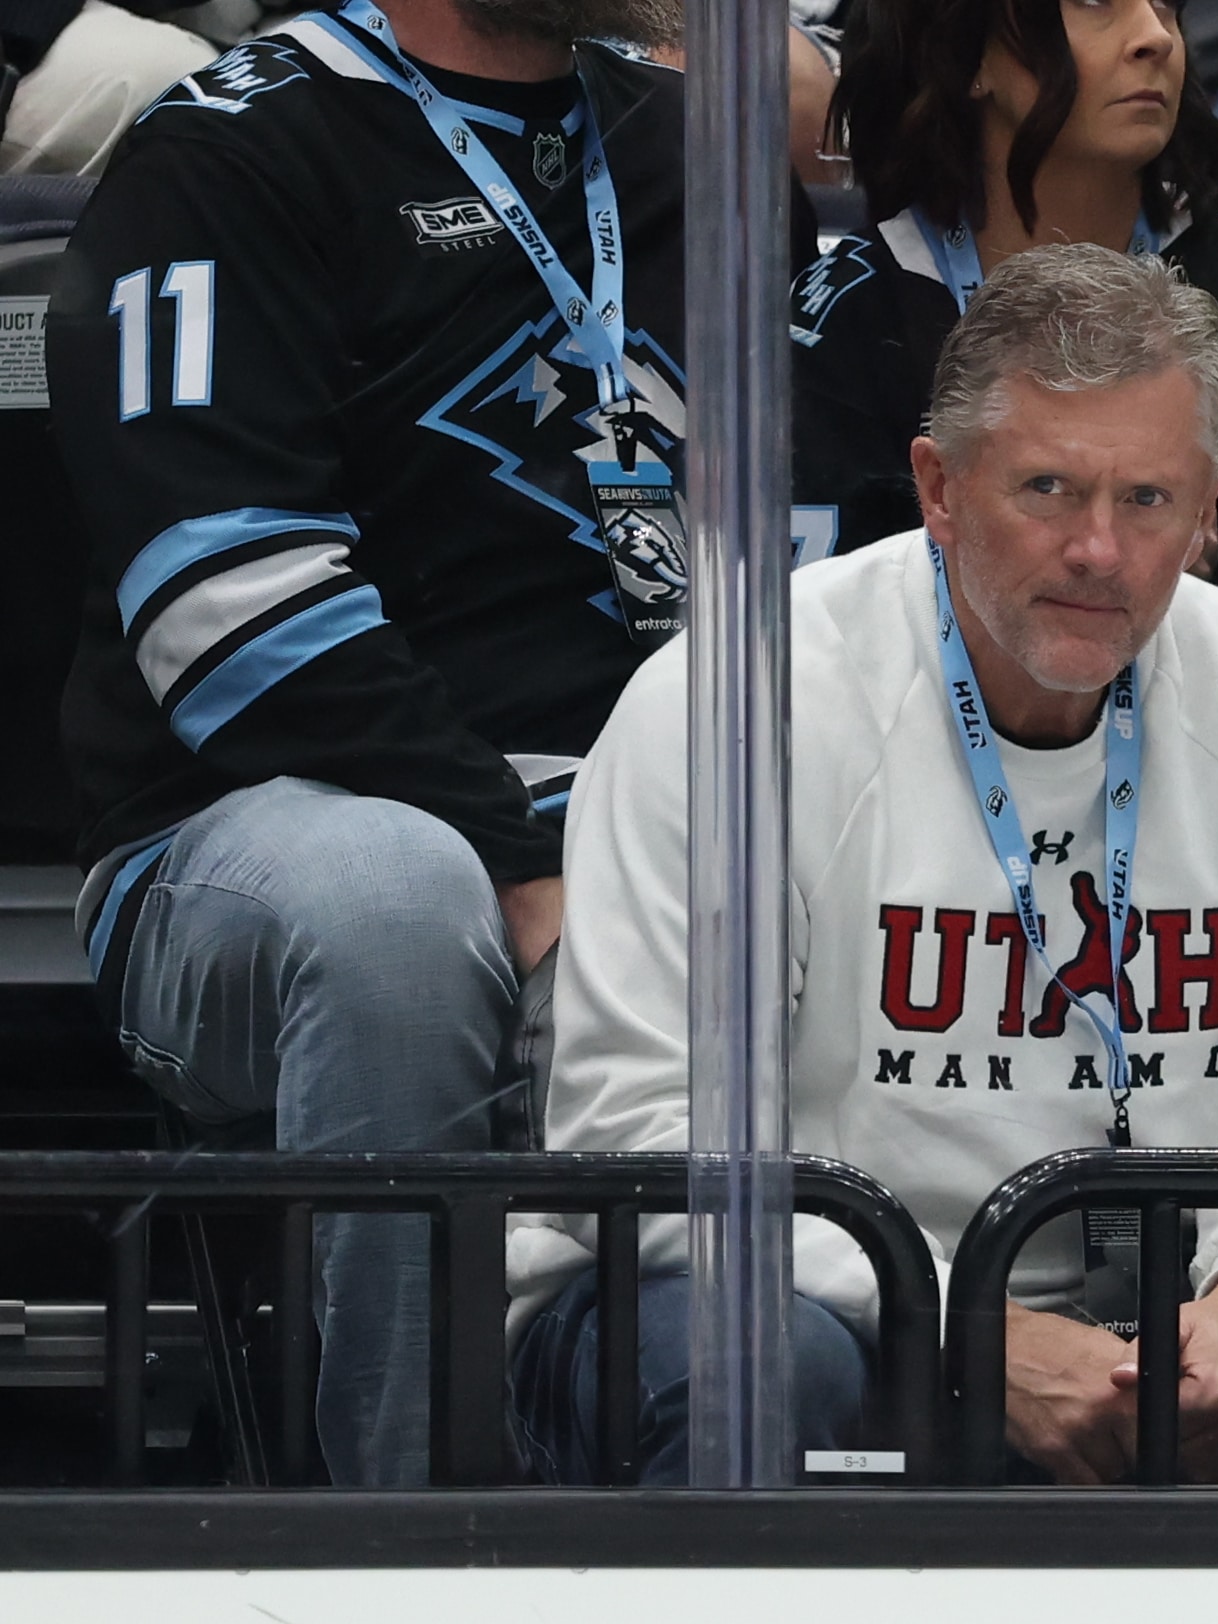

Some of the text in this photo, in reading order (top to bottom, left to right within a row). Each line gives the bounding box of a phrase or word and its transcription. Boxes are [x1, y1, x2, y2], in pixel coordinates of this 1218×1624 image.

[420, 206, 486, 231] SME
[595, 210, 617, 266] UTAH
[440, 236, 496, 252] STEEL
[108, 260, 215, 423] 11
[635, 617, 682, 630] entrata
[952, 681, 987, 749] UTAH
[1112, 849, 1128, 921] UTAH
[844, 1455, 867, 1468] S-3
